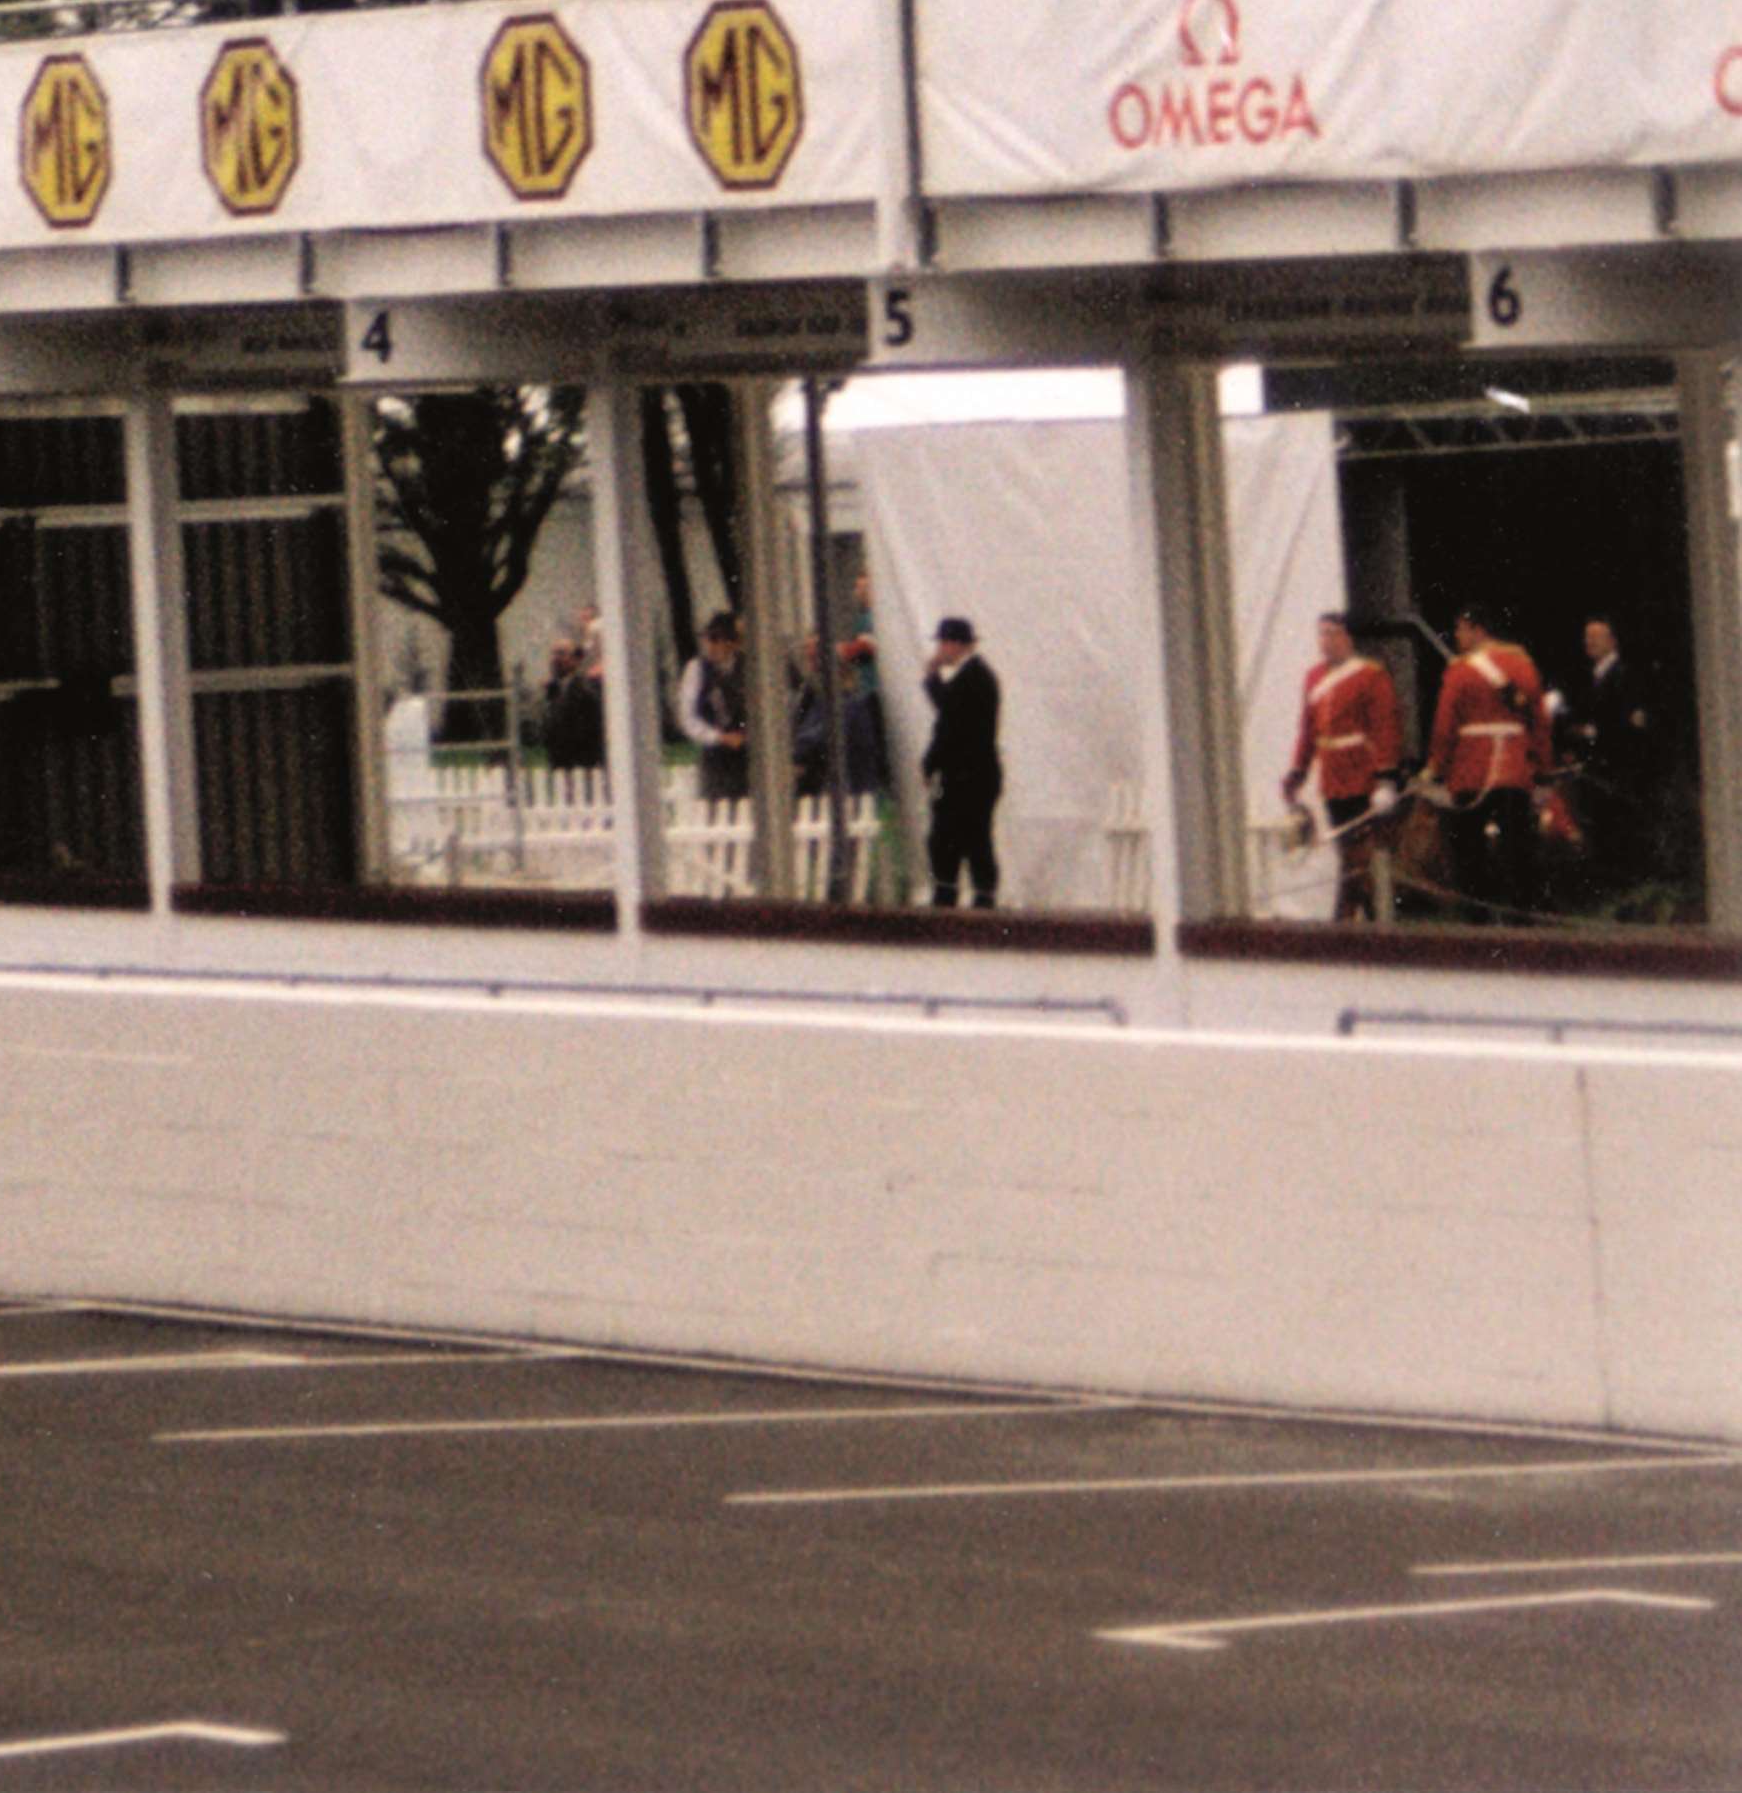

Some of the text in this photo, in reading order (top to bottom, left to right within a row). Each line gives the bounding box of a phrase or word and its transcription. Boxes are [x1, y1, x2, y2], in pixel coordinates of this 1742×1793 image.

[31, 78, 101, 204] MG
[213, 62, 286, 194] MG
[492, 39, 575, 177] MG
[699, 25, 788, 164] MG
[1109, 76, 1320, 149] OMEGA
[360, 310, 393, 363] 4
[883, 289, 915, 346] 5
[1488, 264, 1521, 326] 6
